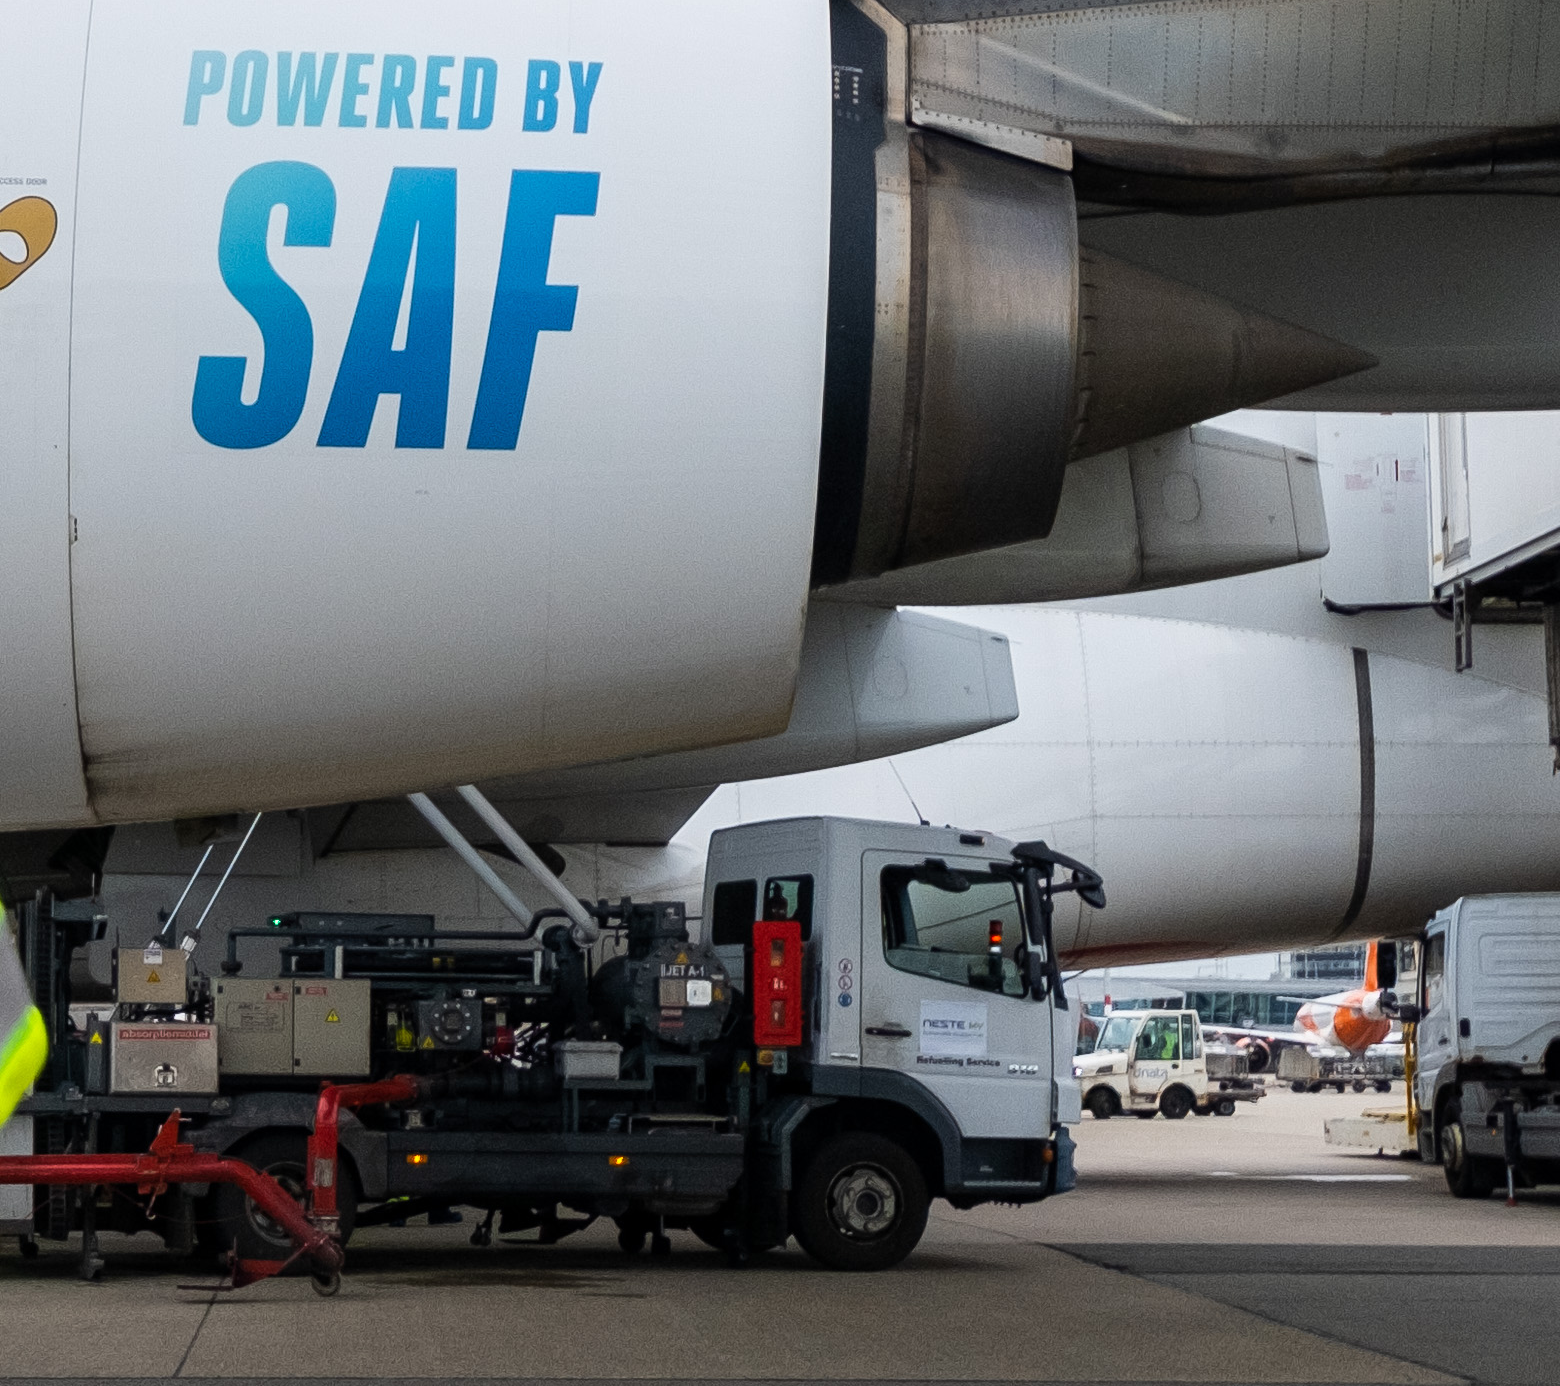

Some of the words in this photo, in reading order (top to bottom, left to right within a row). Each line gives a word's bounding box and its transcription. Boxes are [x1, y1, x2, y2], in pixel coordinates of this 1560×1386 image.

[183, 49, 498, 132] POWERED
[522, 59, 604, 134] BY
[191, 159, 601, 451] SAF
[666, 965, 685, 977] JET
[923, 1019, 965, 1029] NESTE
[1133, 1066, 1169, 1080] dnata
